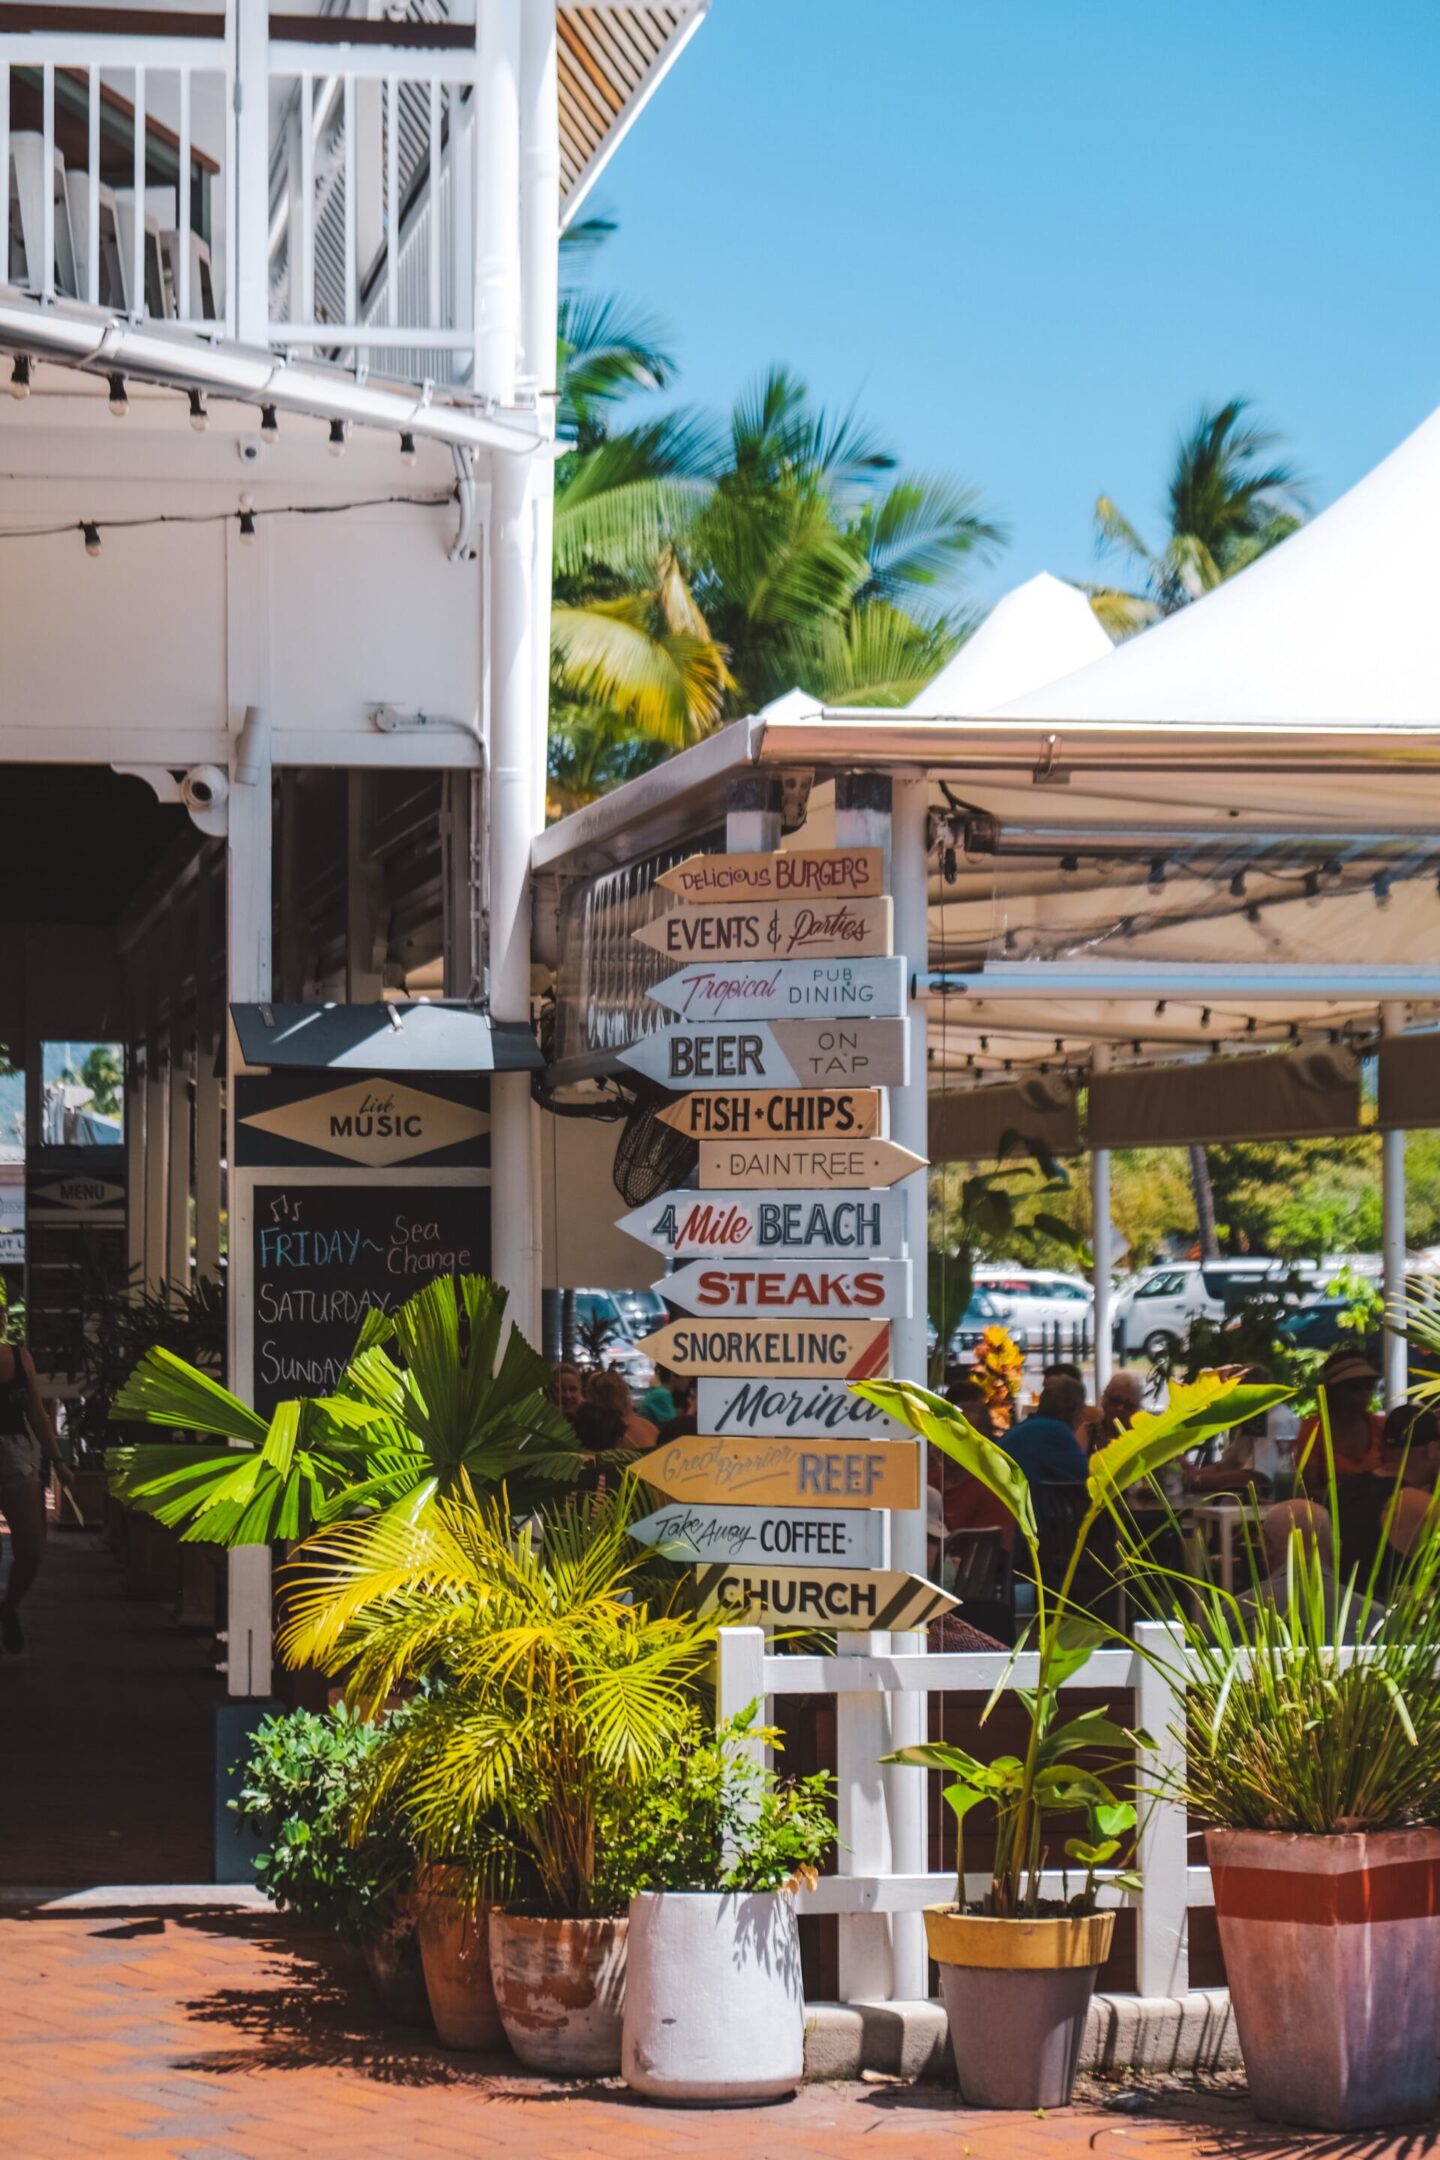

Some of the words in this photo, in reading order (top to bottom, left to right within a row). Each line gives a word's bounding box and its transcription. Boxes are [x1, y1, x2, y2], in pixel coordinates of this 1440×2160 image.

[775, 857, 870, 890] BURGERS
[667, 916, 760, 951] EVENTS
[787, 906, 871, 952] Parties
[682, 970, 782, 1015] Tropical
[813, 968, 854, 982] PUB
[789, 985, 874, 1004] DINING
[670, 1035, 766, 1077] BEER
[818, 1033, 858, 1050] ON
[809, 1056, 870, 1074] TAP
[358, 1093, 396, 1115] Live
[690, 1097, 750, 1132] FISH
[330, 1114, 424, 1138] MUSIC
[729, 1152, 865, 1180] DAINTREE
[60, 1183, 105, 1202] MENU
[260, 1227, 361, 1268] FRIDAY
[390, 1215, 440, 1246] Sea
[652, 1204, 679, 1244] 4
[674, 1204, 753, 1250] Mile
[759, 1202, 882, 1247] BEACH
[386, 1245, 472, 1274] Change
[258, 1283, 391, 1324] SATURDAY
[697, 1271, 886, 1306] STEAKS
[261, 1340, 350, 1385] SUNDAY
[672, 1332, 848, 1363] SNORKELING
[797, 1453, 886, 1496] REEF
[760, 1519, 846, 1555] COFFEE
[717, 1576, 877, 1620] CHURCH
